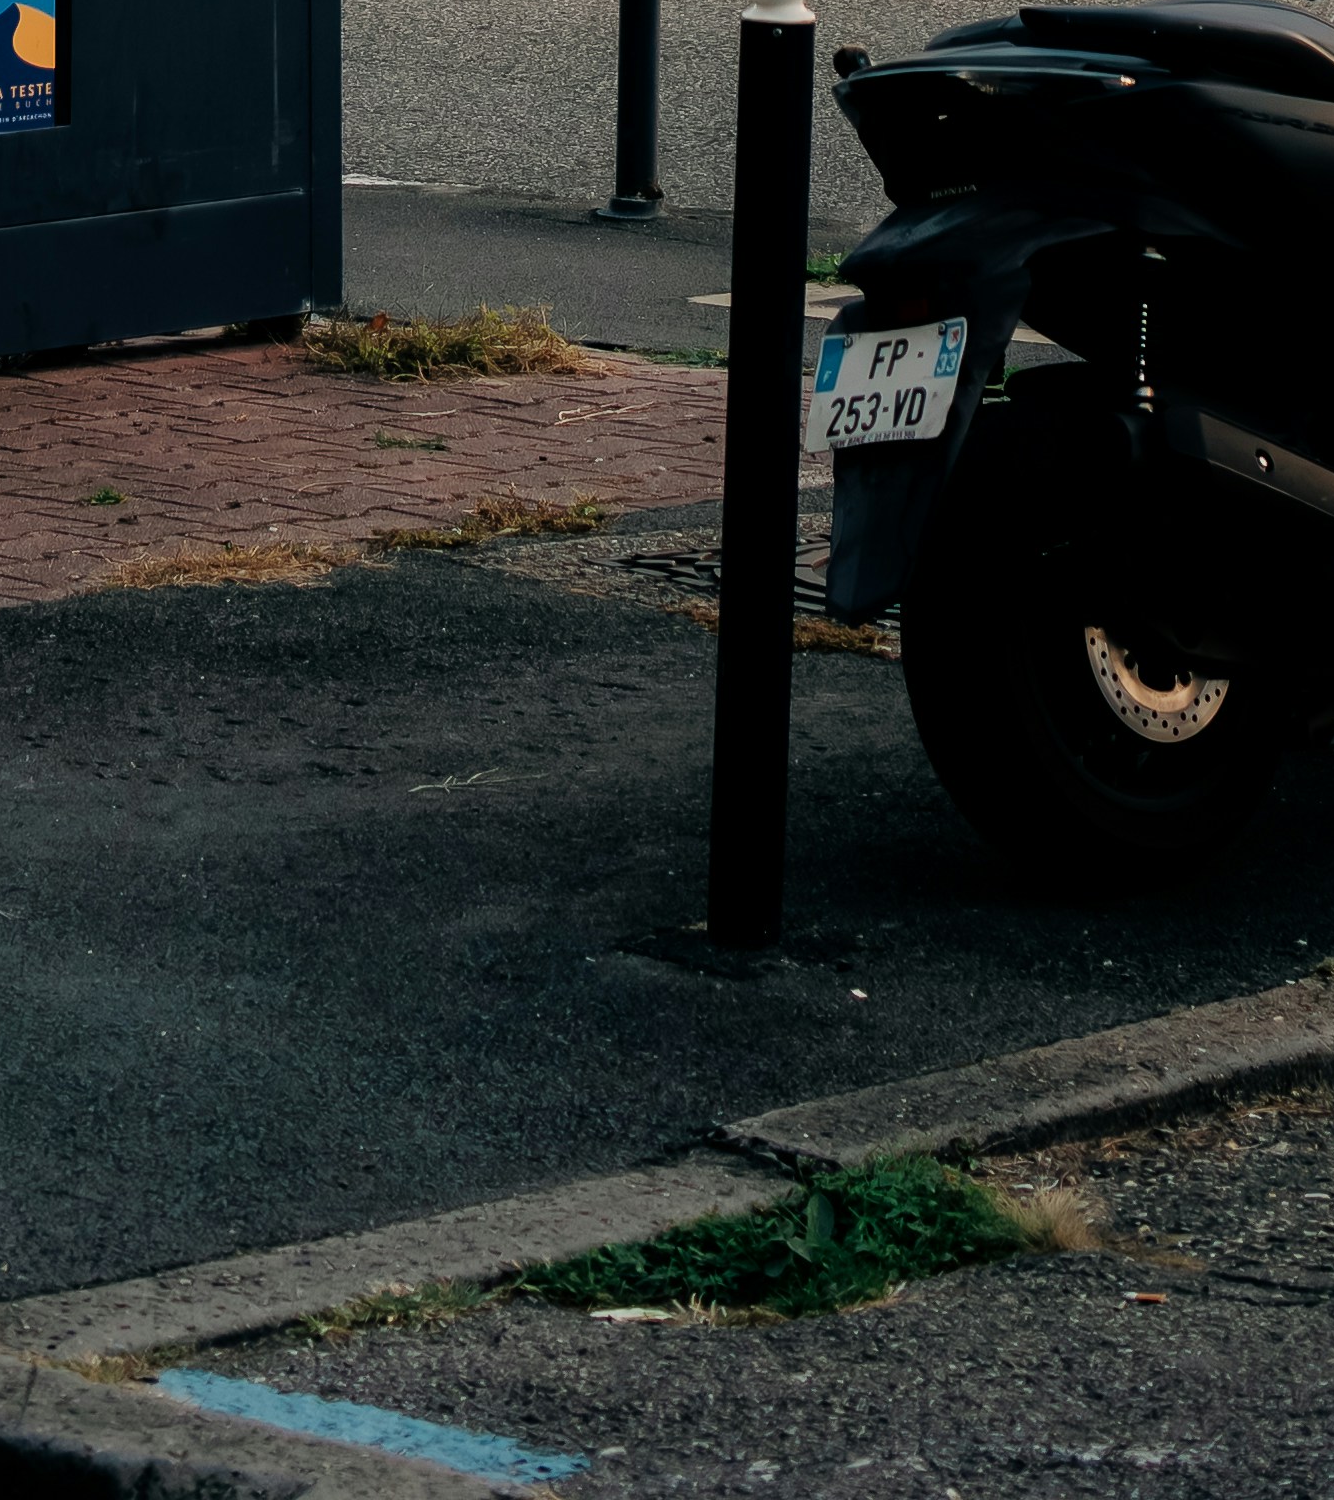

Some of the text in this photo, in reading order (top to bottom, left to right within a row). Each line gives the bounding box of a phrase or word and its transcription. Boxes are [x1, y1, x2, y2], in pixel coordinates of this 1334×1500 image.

[10, 82, 53, 99] TESTE
[930, 183, 978, 200] HONDA
[936, 352, 958, 374] 33
[826, 386, 927, 439] 253-VD
